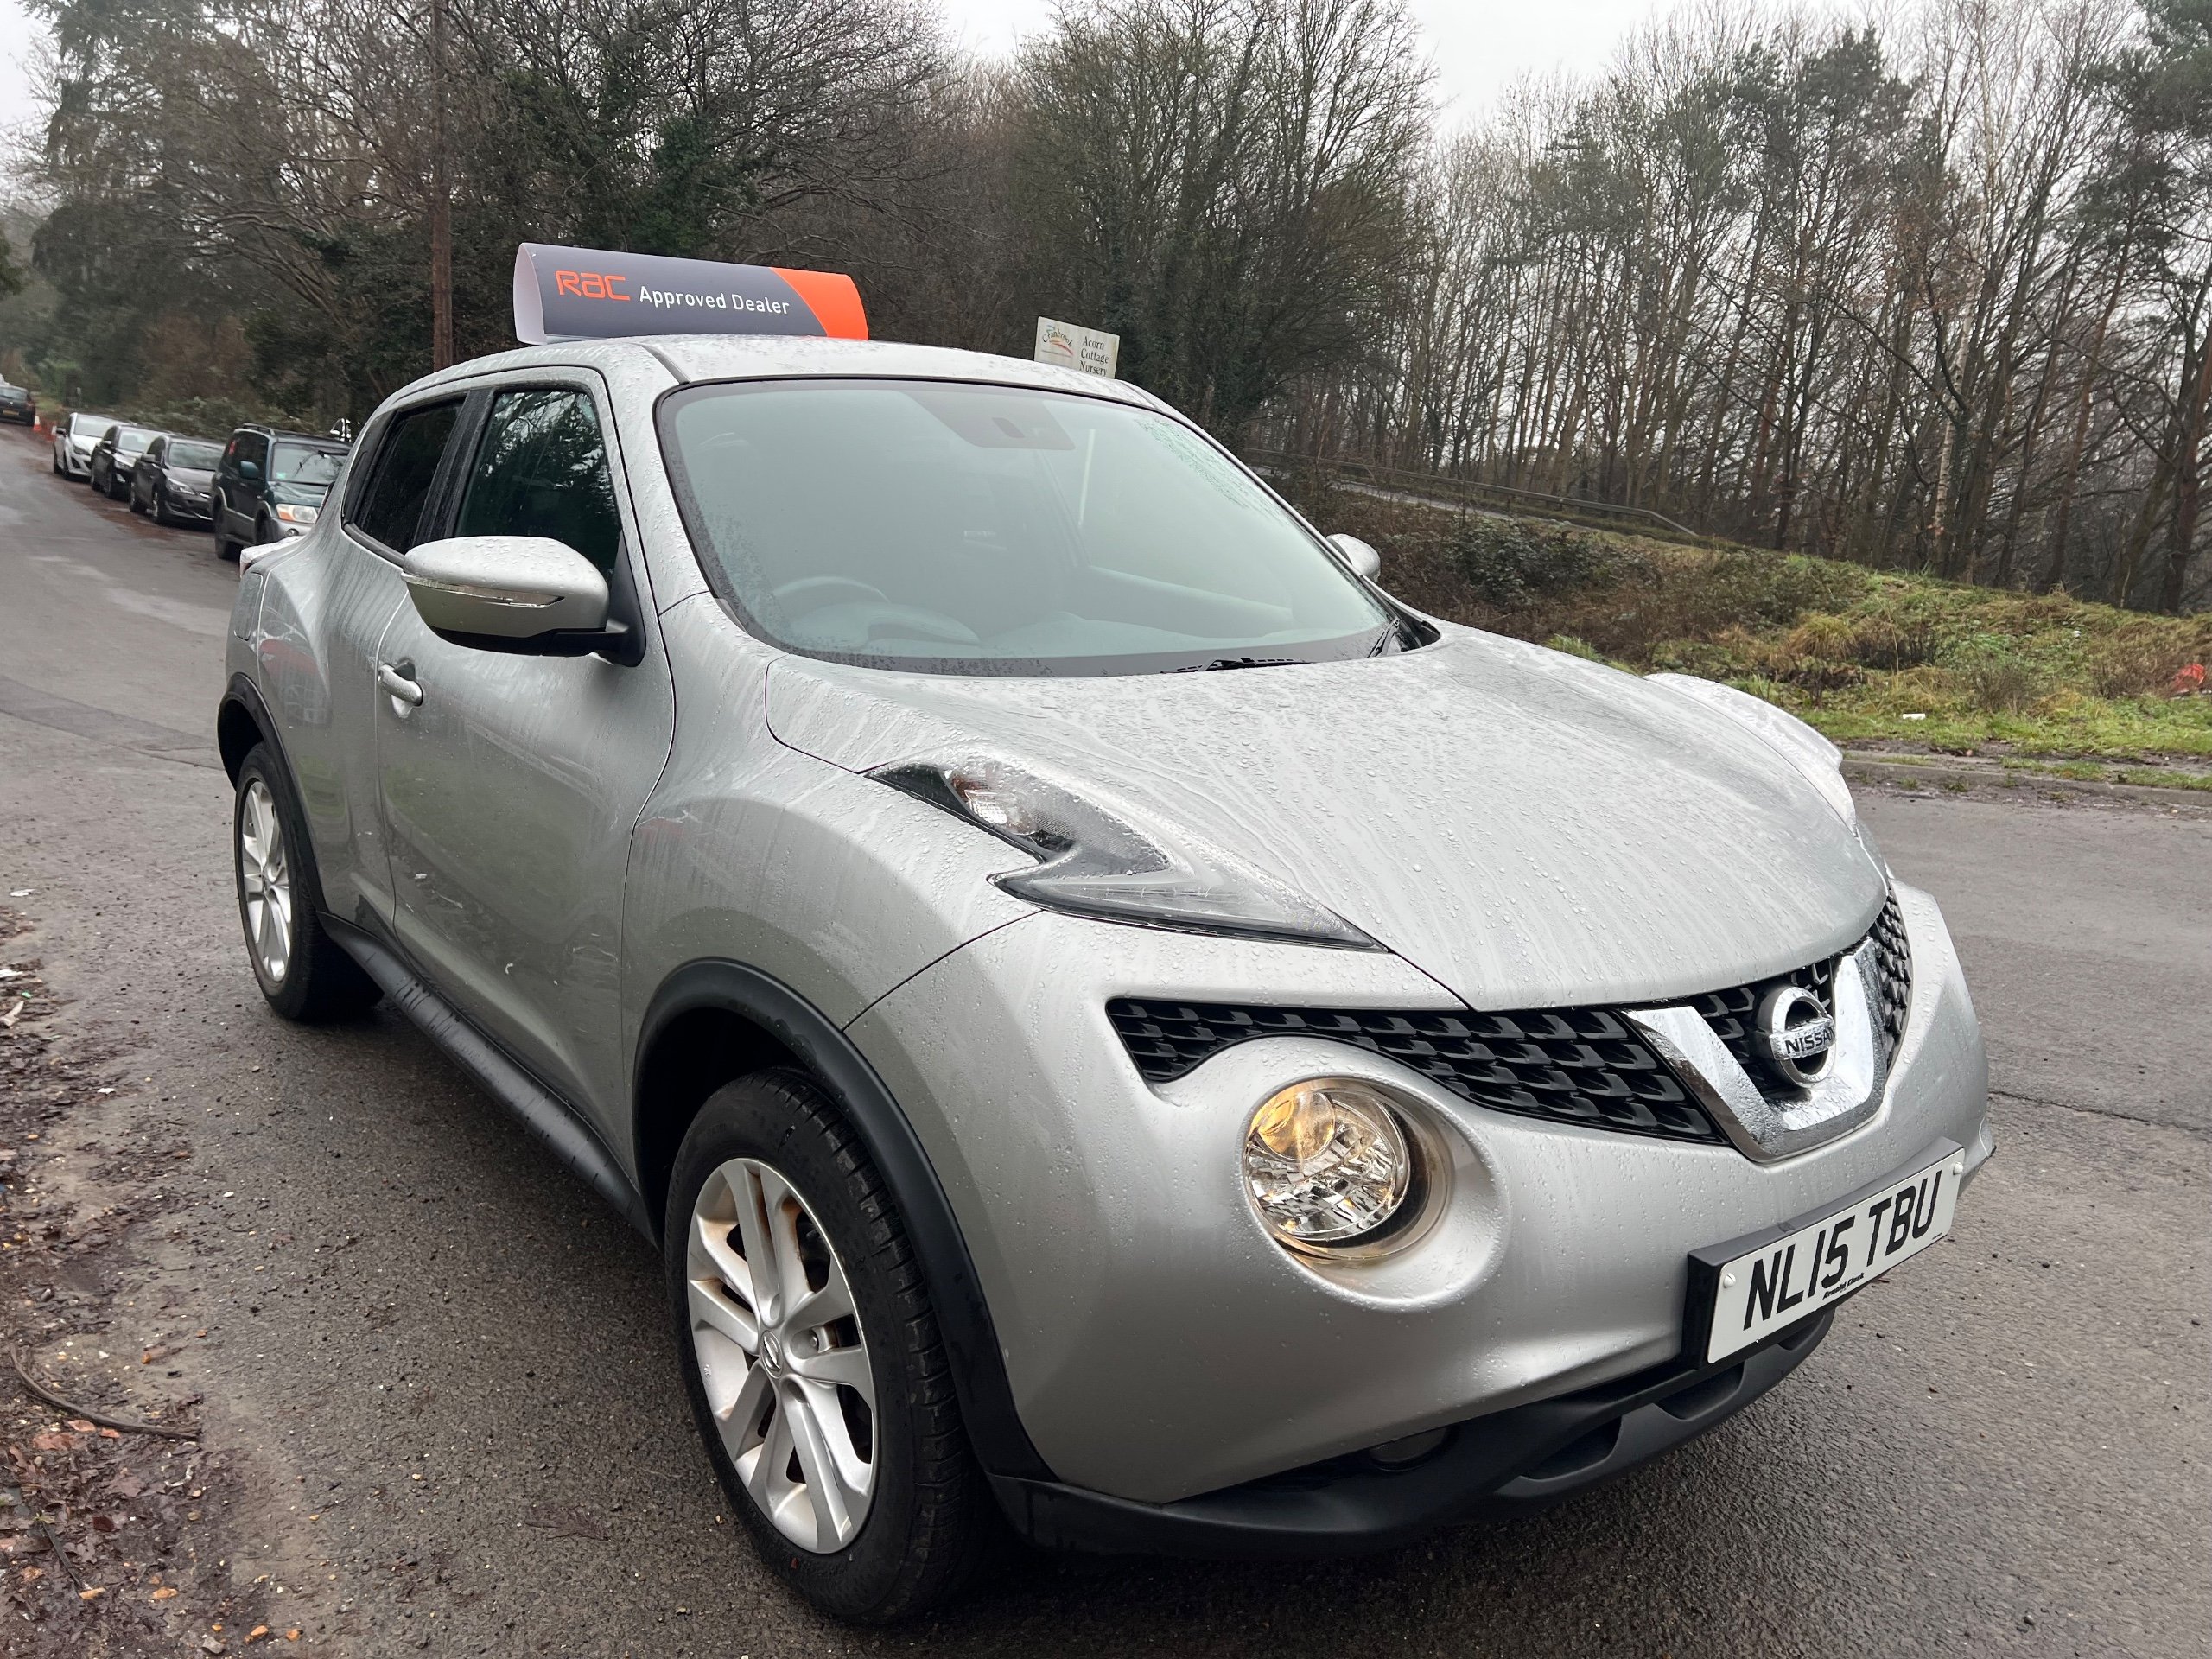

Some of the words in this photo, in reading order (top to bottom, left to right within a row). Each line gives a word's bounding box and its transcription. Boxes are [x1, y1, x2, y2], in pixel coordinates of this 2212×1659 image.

[639, 286, 727, 310] Approved
[733, 292, 790, 315] Dealer
[1083, 335, 1105, 351] Acorn
[1080, 347, 1109, 365] Cottage
[1078, 359, 1108, 377] Nursery
[1743, 1215, 1856, 1332] NL15
[1866, 1169, 1942, 1268] TBU
